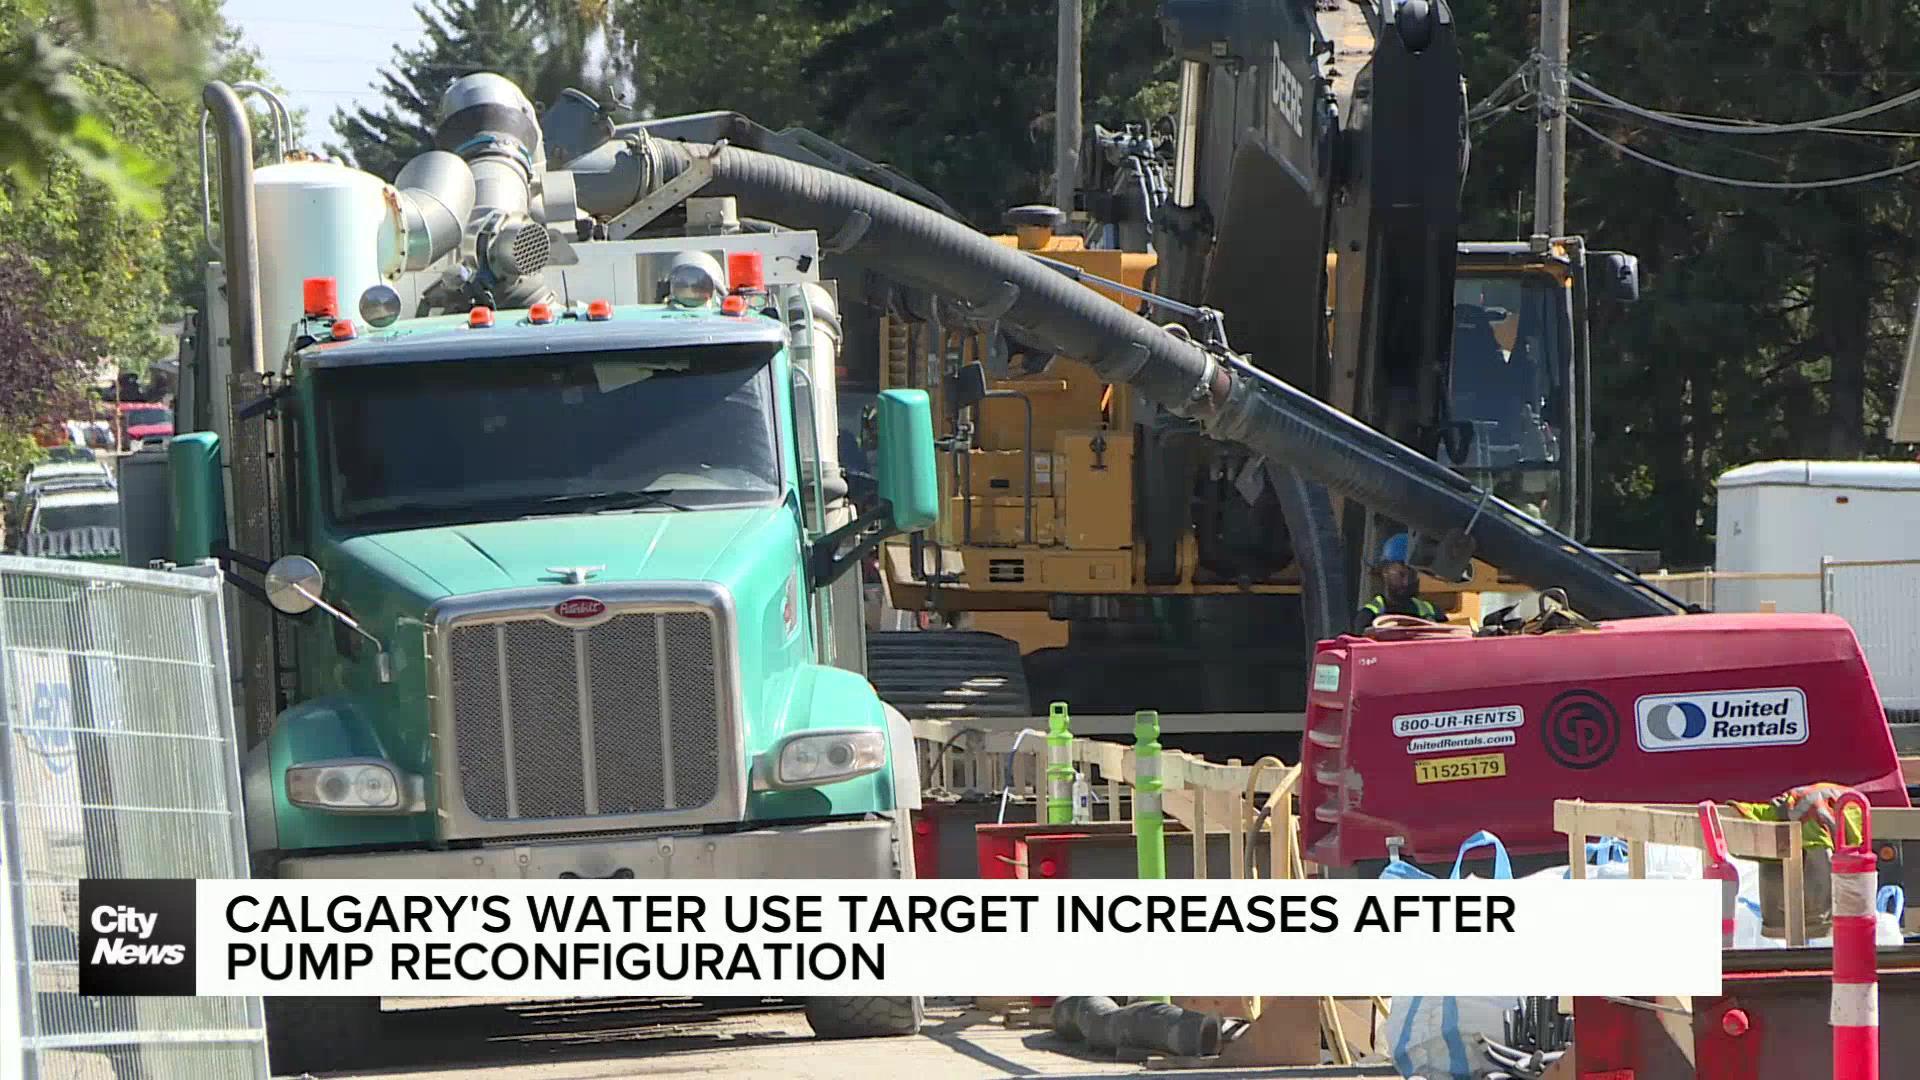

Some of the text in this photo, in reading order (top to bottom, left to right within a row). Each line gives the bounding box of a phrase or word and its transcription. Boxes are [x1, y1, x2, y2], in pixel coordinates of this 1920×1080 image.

[1273, 40, 1303, 138] DEERE
[1711, 698, 1790, 719] United
[1400, 710, 1517, 732] 800-UR-RENTS
[1712, 719, 1798, 738] Rentals
[1408, 735, 1513, 752] UnitedRentals.com
[1421, 760, 1500, 780] 11525179
